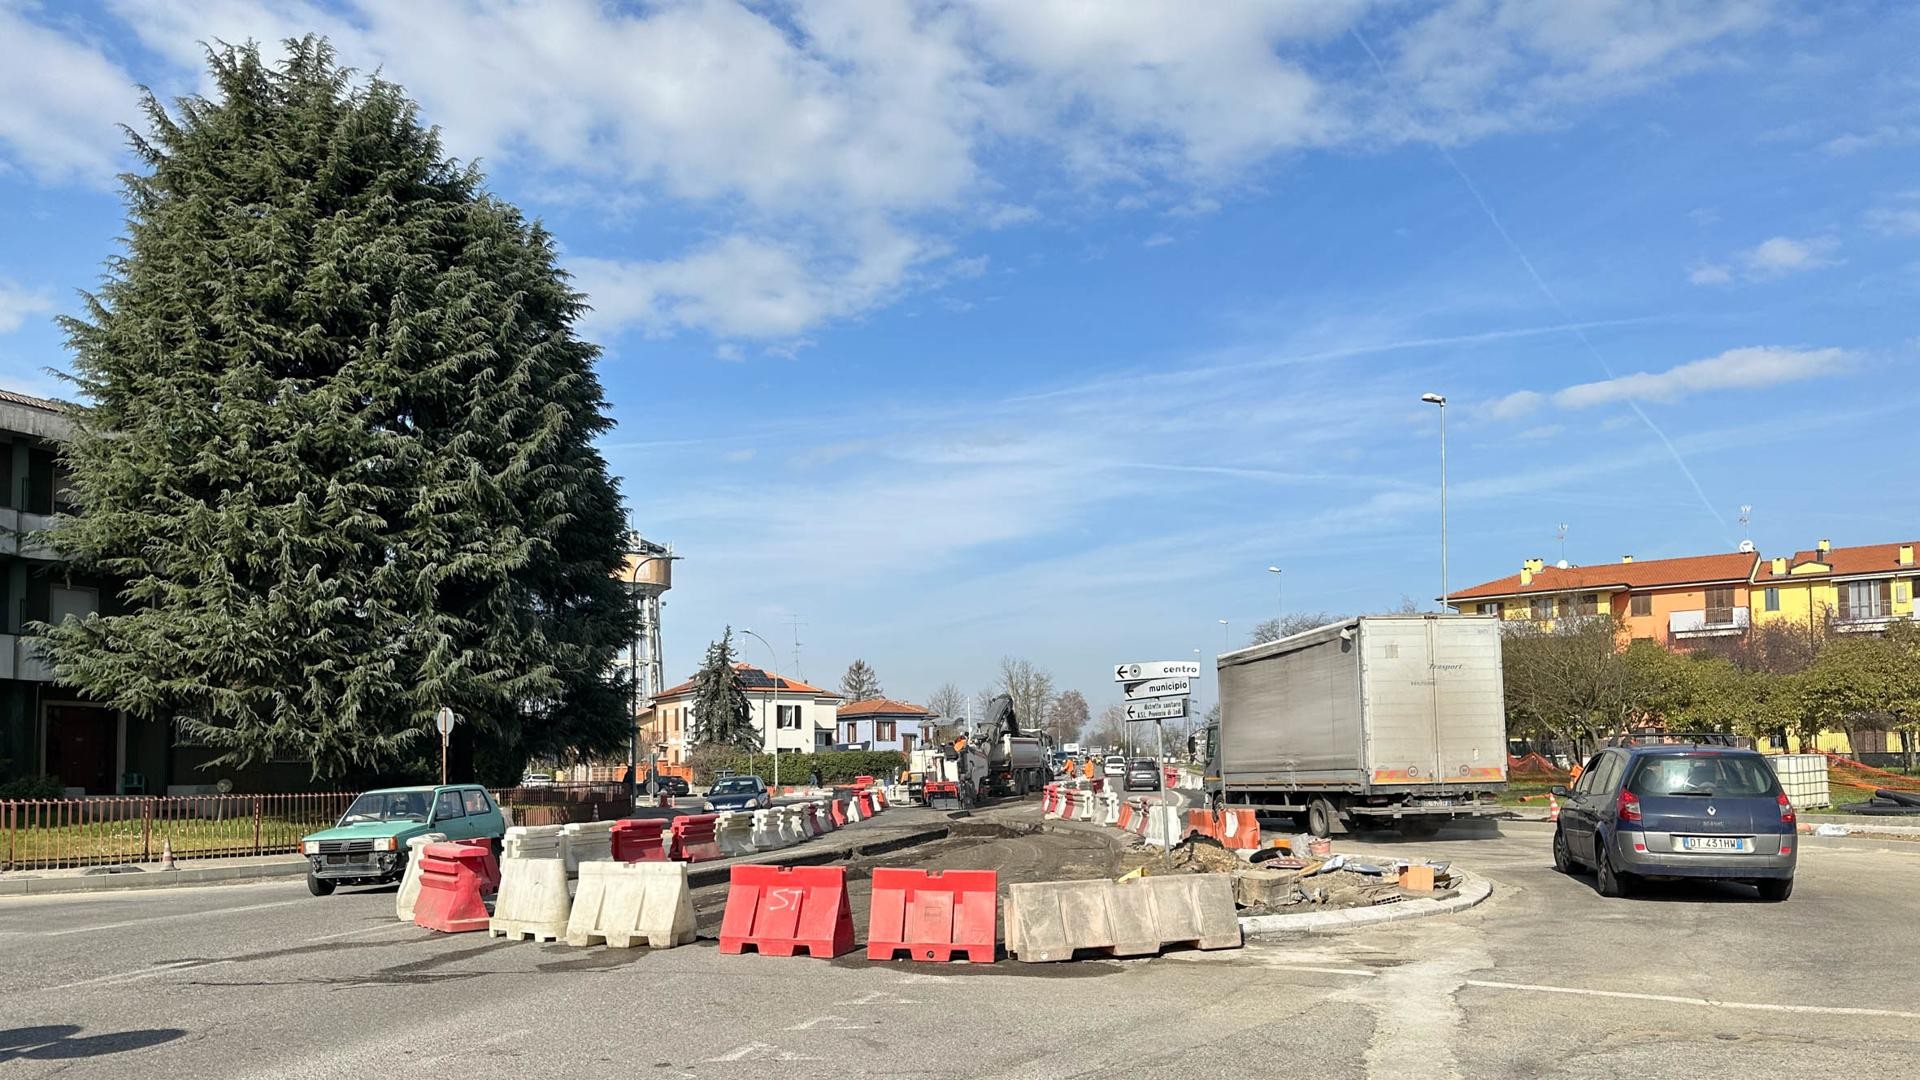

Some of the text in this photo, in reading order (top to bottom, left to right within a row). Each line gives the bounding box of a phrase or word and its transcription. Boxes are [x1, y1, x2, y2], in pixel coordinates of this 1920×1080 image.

[1163, 665, 1197, 674] centro
[1149, 681, 1188, 692] municipio
[1690, 838, 1736, 848] DT 431HW
